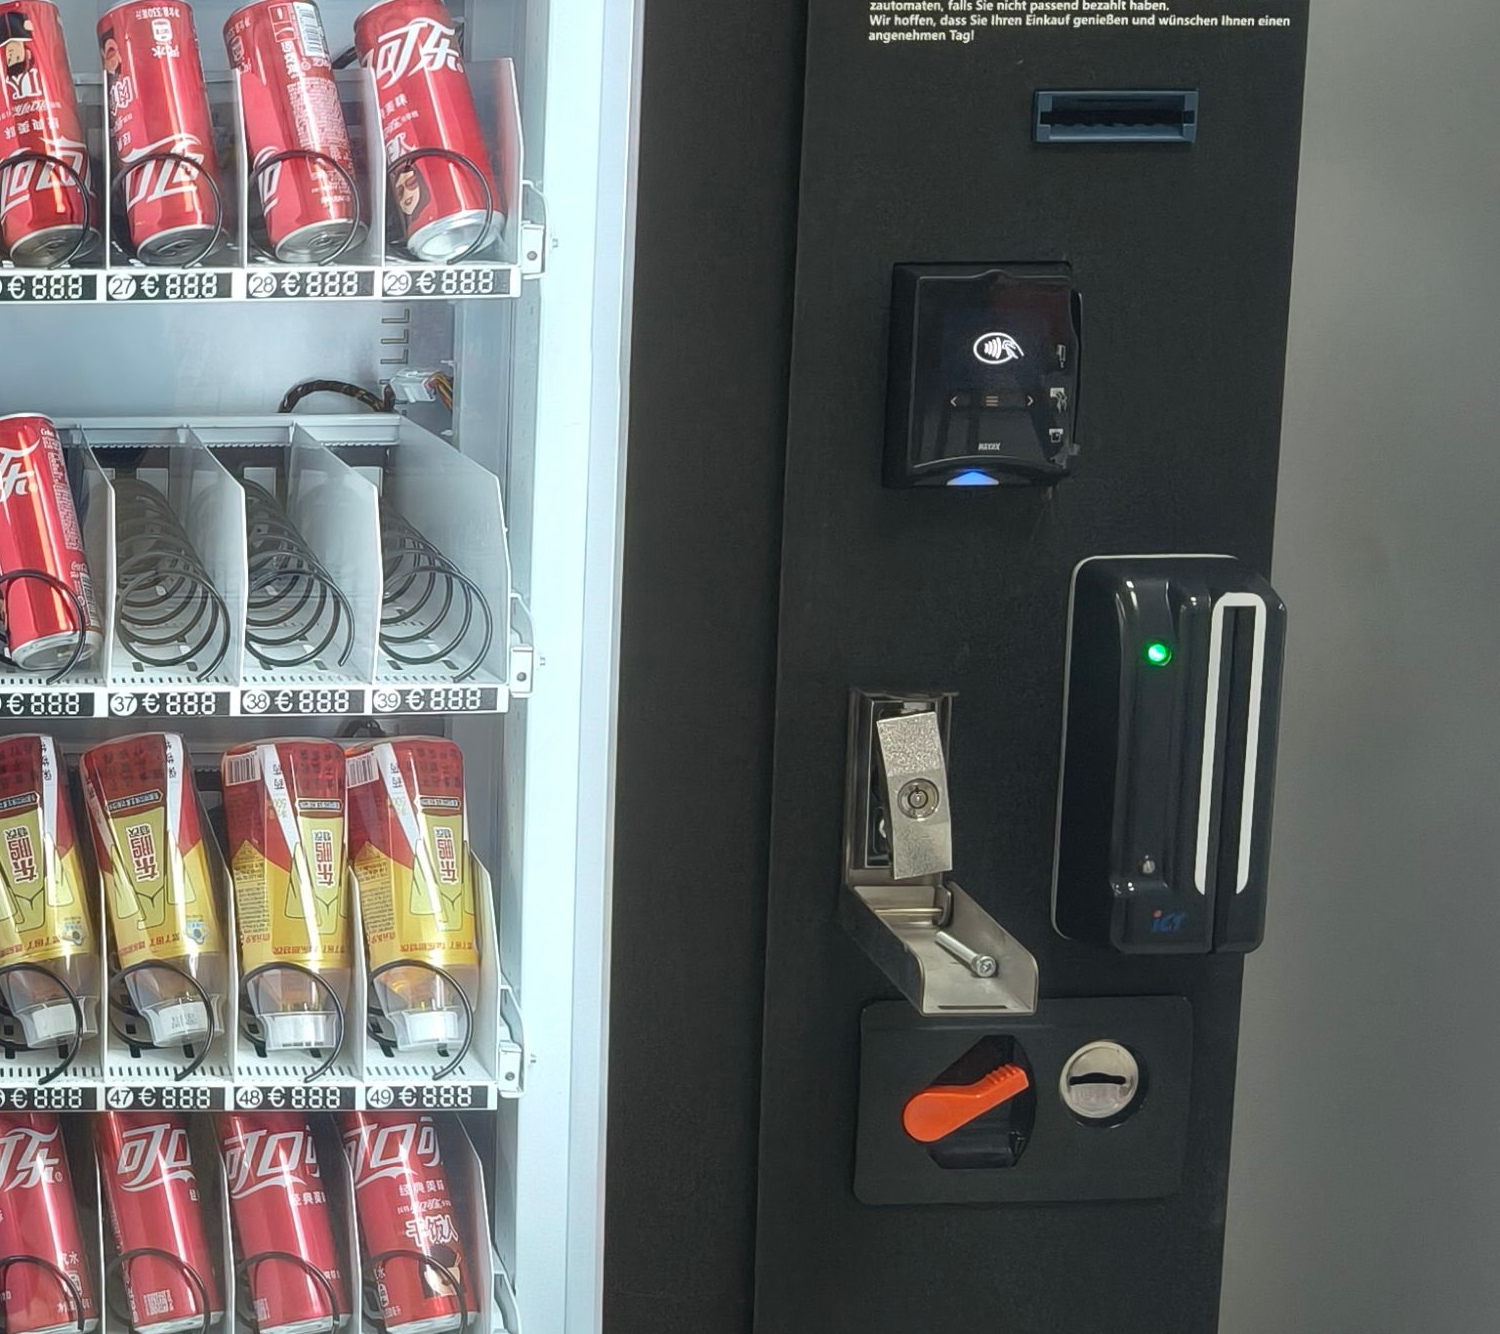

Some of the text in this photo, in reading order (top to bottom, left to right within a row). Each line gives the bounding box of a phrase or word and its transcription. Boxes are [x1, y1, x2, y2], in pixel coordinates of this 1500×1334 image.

[388, 275, 409, 290] 29
[377, 692, 397, 707] 39
[371, 1090, 392, 1104] 49
